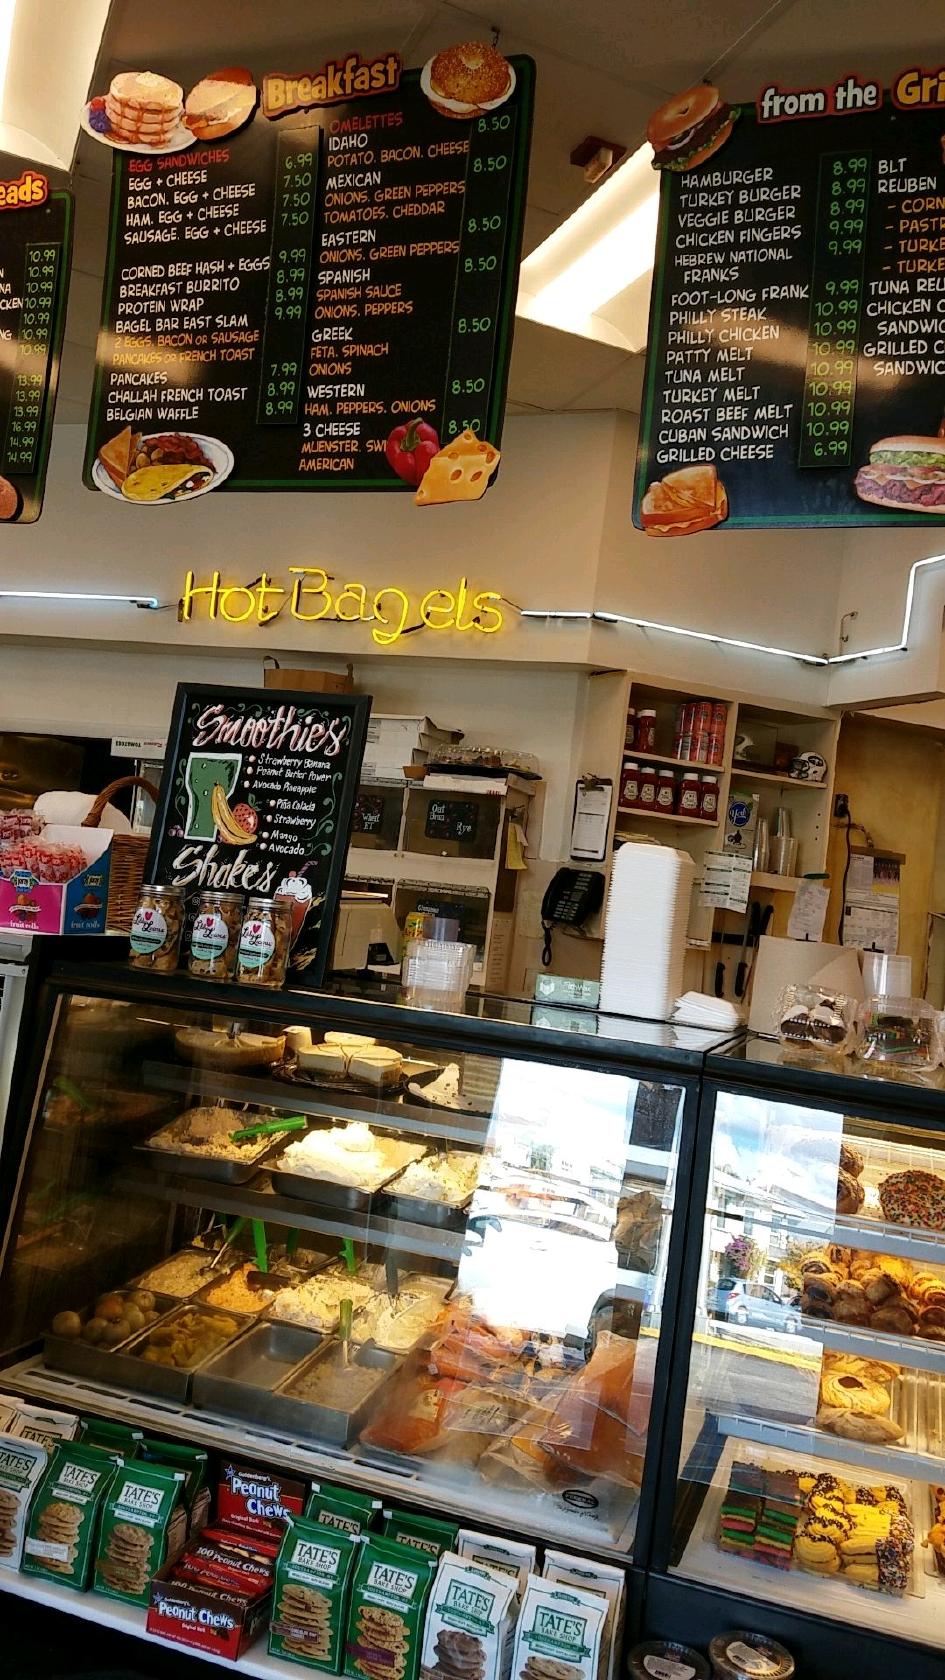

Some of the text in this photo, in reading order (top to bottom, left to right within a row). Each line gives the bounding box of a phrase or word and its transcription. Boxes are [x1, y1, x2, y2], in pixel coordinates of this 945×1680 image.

[266, 57, 397, 108] Breakfast
[762, 71, 945, 118] from the Gri
[329, 112, 403, 134] OMELETTES
[477, 115, 511, 133] 8.50
[329, 134, 368, 151] IDAHO
[428, 140, 470, 158] CHEESE
[128, 149, 229, 172] EGG SANDWICHES
[285, 153, 312, 169] 6.99
[473, 155, 507, 173] 8.50
[833, 158, 867, 176] 8.99
[878, 158, 907, 174] BLT
[129, 170, 207, 190] EGG CHEESE
[284, 173, 311, 187] 7.50
[326, 171, 381, 191] MEXICAN
[681, 167, 774, 188] HAMBURGER
[878, 177, 937, 193] REUBEN
[174, 184, 255, 204] EGG CHEESE
[374, 180, 465, 201] GREEN PEPPERS
[831, 178, 866, 196] 8.99
[283, 193, 310, 207] 7.50
[680, 185, 801, 208] TURKEY BURGER
[159, 204, 239, 224] EGG CHEESE
[393, 201, 445, 219] CHEDDAR
[678, 205, 796, 228] VEGGIE BURGER
[185, 220, 267, 240] EGG CHEESE
[467, 215, 501, 233] 8.50
[829, 219, 864, 235] 9.99
[321, 230, 376, 247] EASTERN
[675, 225, 802, 249] CHICKEN FINGERS
[28, 250, 56, 263] 10.99
[369, 241, 460, 261] GREEN PEPPERS
[675, 248, 793, 267] HEBREW NATIONAL
[27, 265, 55, 278] 10.99
[121, 256, 270, 280] CORNED BEEF HASH EGGS
[277, 269, 305, 284] 8.99
[318, 268, 370, 285] SPANISH
[684, 266, 739, 284] FRANKS
[120, 277, 240, 298] BREAKFAST BURRITO
[316, 283, 402, 302] SPANISH SAUCE
[671, 284, 810, 307] FOOT-LONG FRANK
[825, 280, 859, 296] 9.99
[869, 280, 910, 296] TUNA
[118, 298, 204, 315] PROTEIN WRAP
[364, 301, 413, 316] PEPPERS
[866, 299, 931, 317] CHICKEN
[116, 314, 249, 333] BAGEL BAR EAST SLAM
[458, 317, 491, 334] 8.50
[670, 307, 767, 326] PHILLY STEAK
[157, 330, 259, 347] BACON SAUSAGE
[311, 326, 353, 342] GREEK
[668, 325, 780, 345] PHILLY CHICKEN
[112, 348, 255, 365] PANCAKES FRENCH TOAST
[342, 342, 389, 357] SPINACH
[666, 346, 754, 365] PATTY MELT
[863, 340, 928, 357] GRILLED
[271, 362, 297, 376] 7.99
[309, 362, 352, 376] ONIONS
[665, 367, 745, 384] TUNA MELT
[110, 372, 168, 386] PANCAKES
[108, 388, 248, 404] CHALLAH FRENCH TOAST
[307, 383, 365, 399] WESTERN
[663, 386, 761, 404] TURKEY MELT
[106, 406, 199, 421] BELGIAN WAFFLE
[391, 399, 436, 412] ONIONS
[661, 404, 793, 424] ROAST BEEF MELT
[807, 401, 851, 417] 10.99
[303, 422, 361, 437] 3 CHEESE
[658, 424, 789, 445] CUBAN SANDWICH
[806, 421, 849, 437] 10.99
[7, 451, 32, 463] 14.99
[656, 444, 774, 464] GRILLED CHEESE
[814, 440, 848, 457] 6.99
[299, 457, 354, 471] AMERICAN
[183, 567, 503, 644] Hot Bagels
[192, 703, 347, 757] Smoothies
[258, 753, 331, 770] Strawberry Banana
[256, 765, 331, 783] Peanut Butter Power
[252, 781, 317, 795] Avocado Pineapple
[292, 800, 315, 812] Colada
[274, 813, 316, 828] Strawberry
[270, 830, 298, 842] Mango
[268, 842, 305, 855] Avocado
[171, 843, 281, 892] Shakes
[64, 1466, 98, 1484] TATE'S
[124, 1485, 161, 1505] TATE'S
[232, 1477, 279, 1501] Peanut
[247, 1498, 290, 1518] Chews
[197, 1547, 214, 1557] 100
[213, 1555, 241, 1567] Peanut
[242, 1563, 270, 1577] Chews
[298, 1543, 337, 1565] TATE'S
[374, 1565, 415, 1589] TATE'S
[451, 1585, 490, 1612] TATE'S
[159, 1601, 196, 1621] Peanut
[199, 1609, 234, 1629] Chews
[539, 1612, 583, 1637] TATE'S
